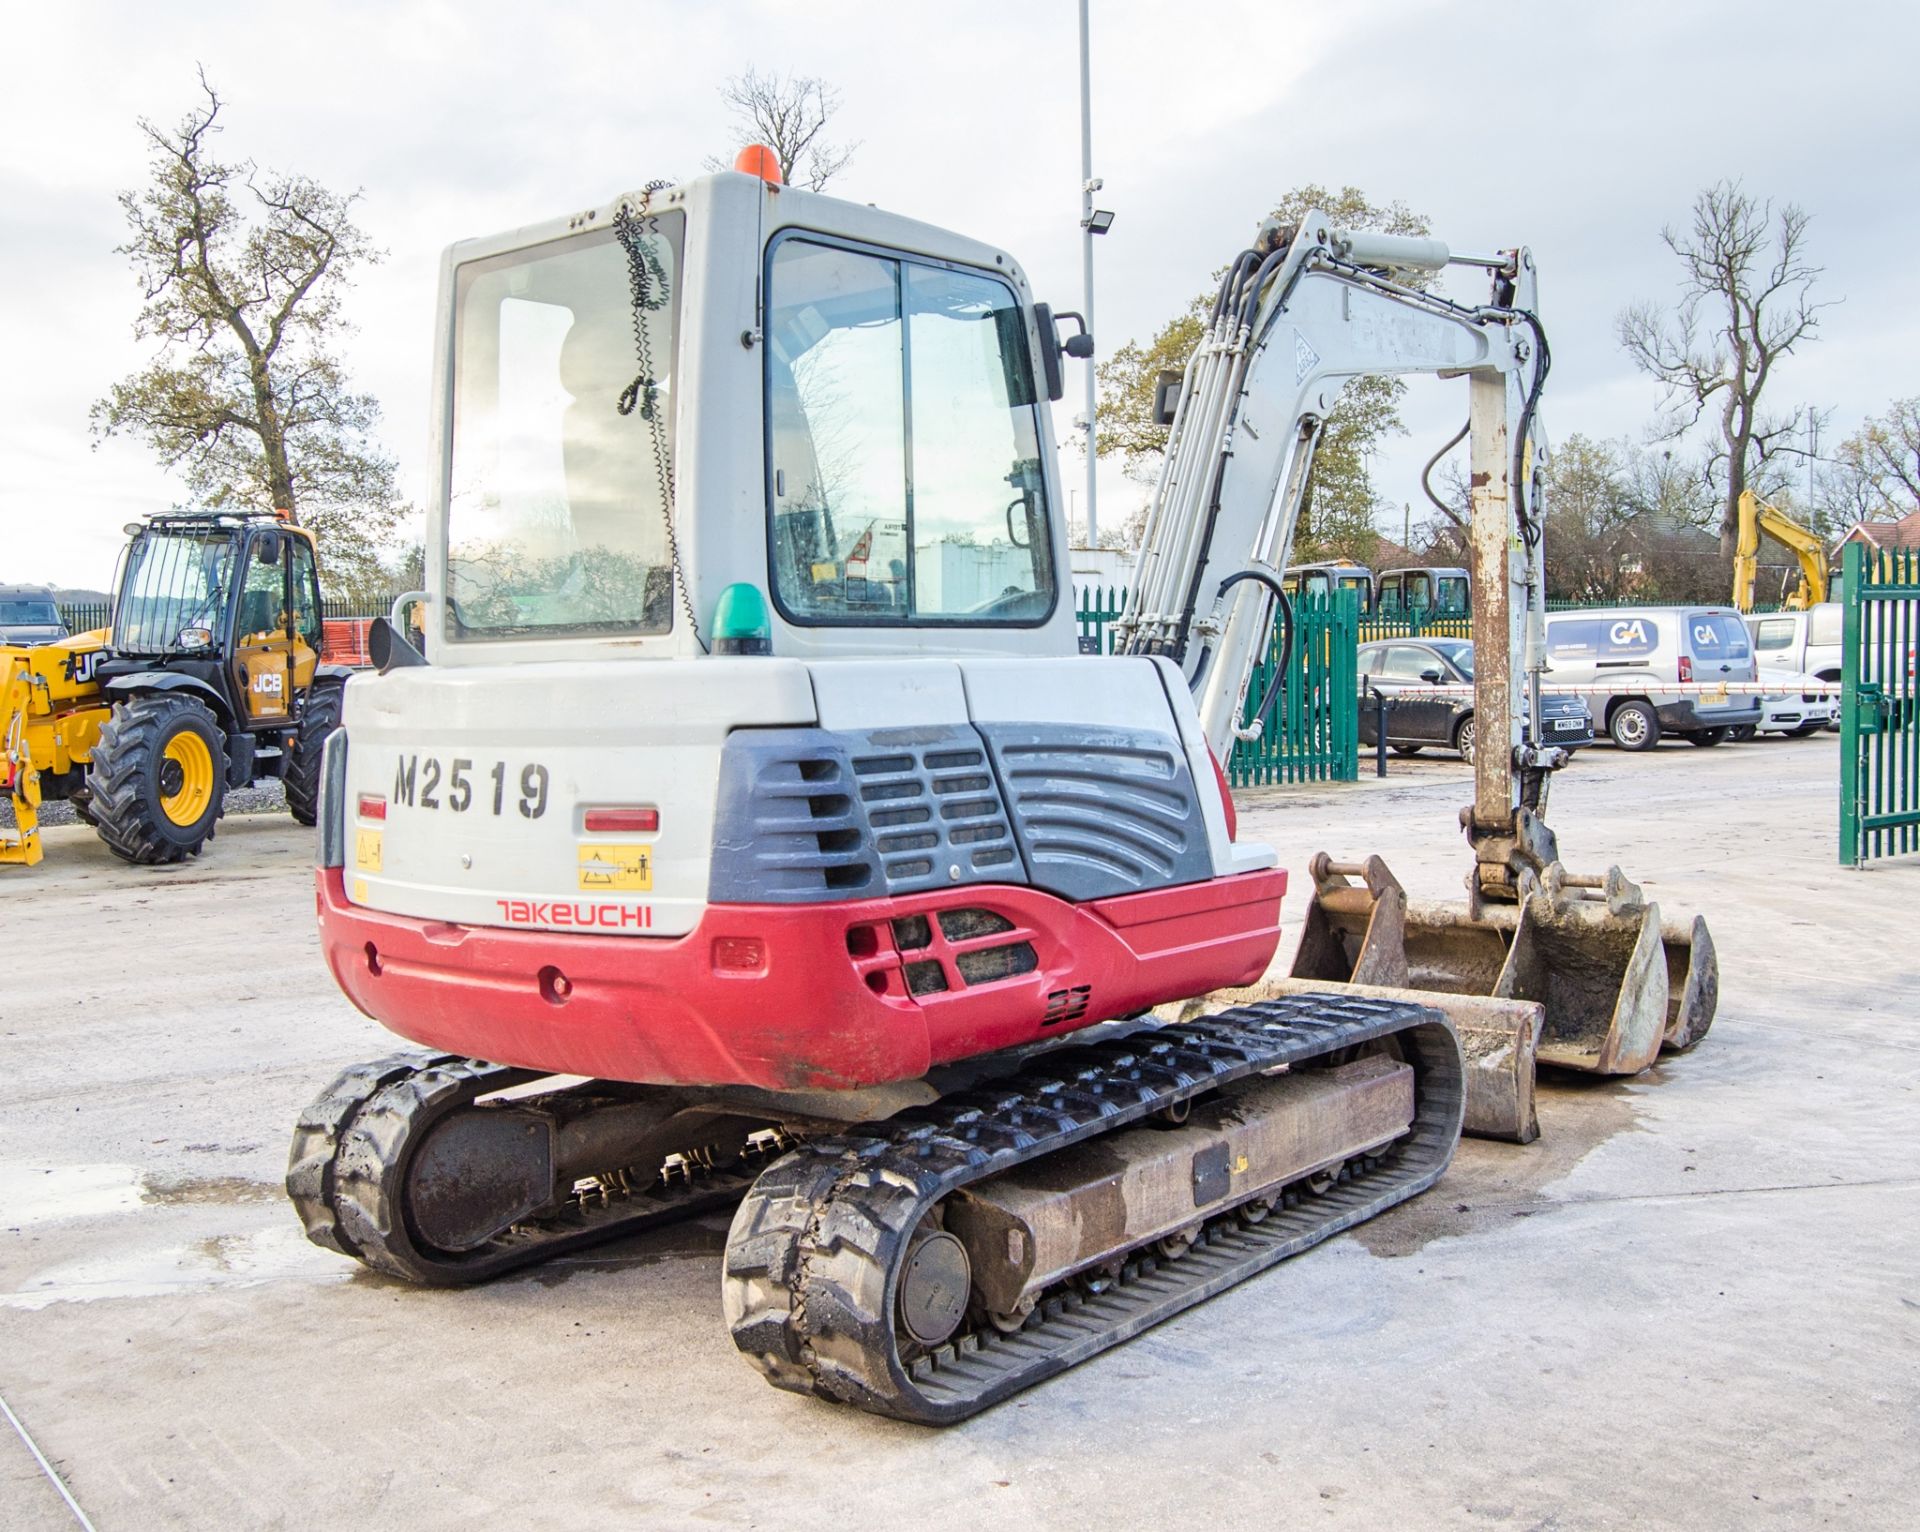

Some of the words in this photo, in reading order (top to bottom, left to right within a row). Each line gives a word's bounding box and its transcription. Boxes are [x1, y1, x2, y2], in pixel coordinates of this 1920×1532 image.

[1610, 620, 1648, 645] GA
[1694, 624, 1719, 645] GA
[75, 651, 108, 682] JC
[253, 673, 283, 693] JCB
[394, 754, 549, 819] M2519
